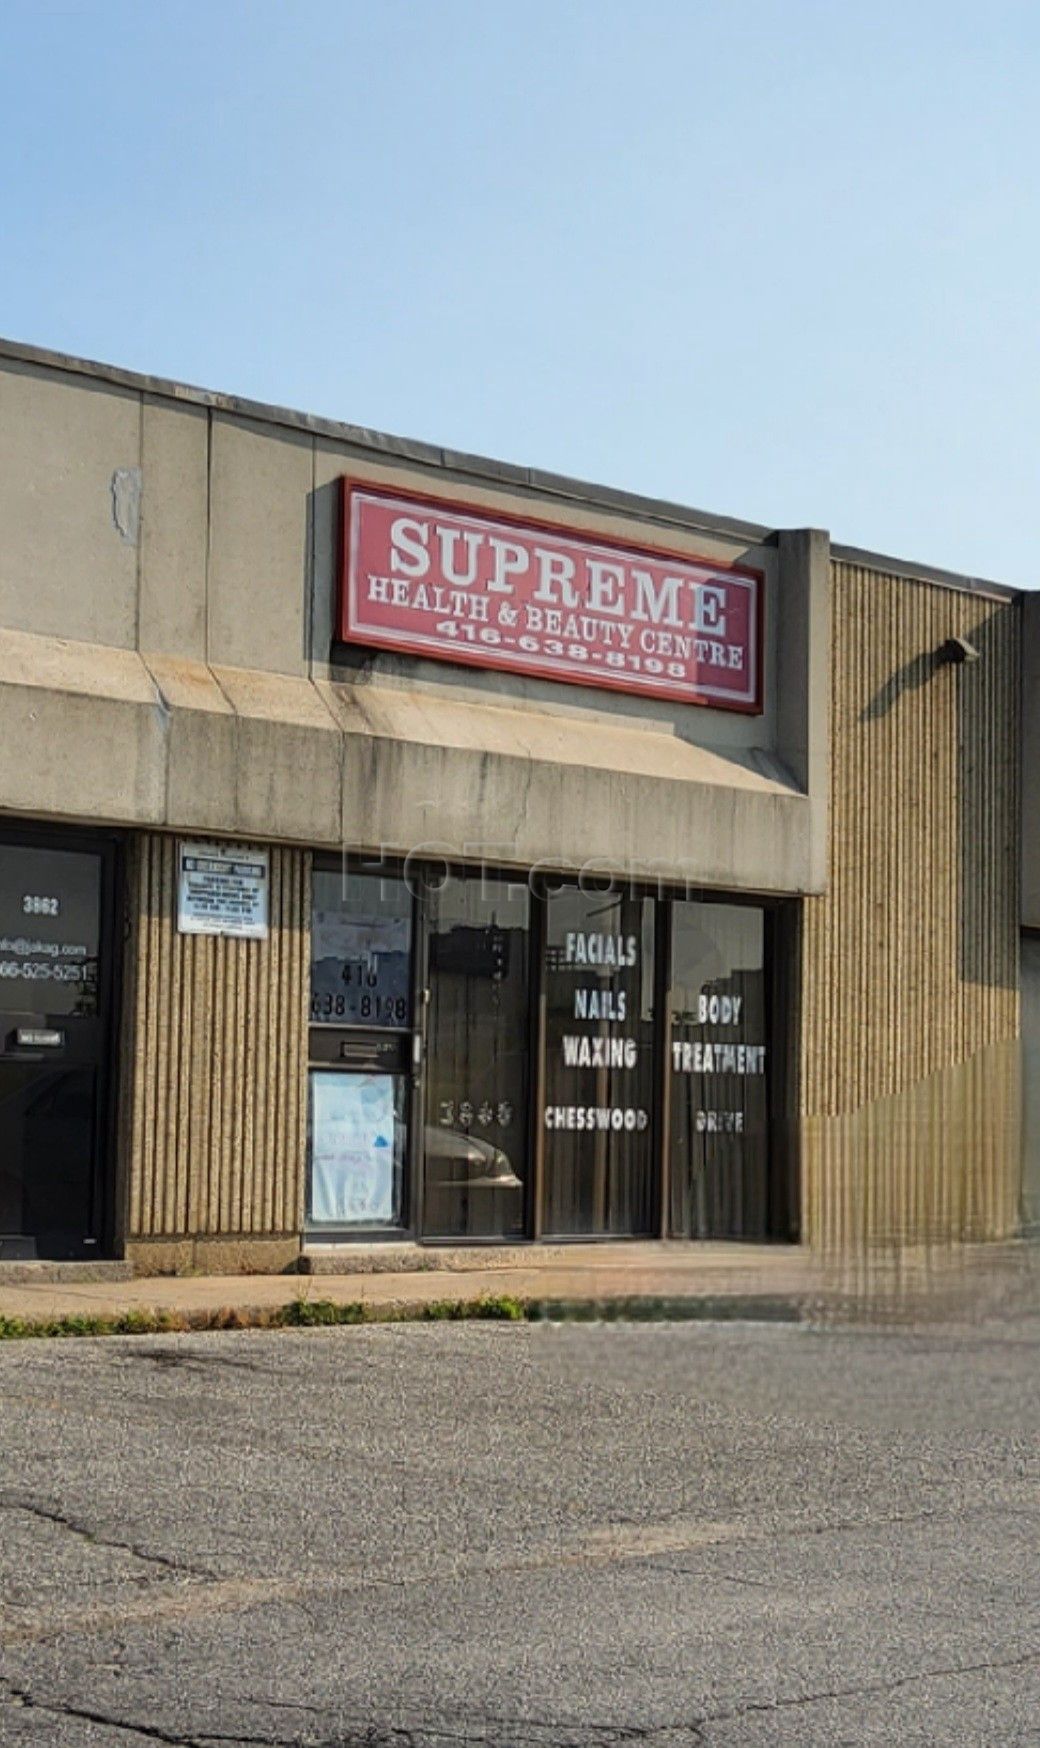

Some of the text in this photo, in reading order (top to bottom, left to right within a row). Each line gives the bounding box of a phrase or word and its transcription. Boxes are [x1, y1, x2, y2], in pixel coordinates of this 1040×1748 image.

[391, 517, 727, 637] SUPREME
[367, 575, 744, 671] HEALTH & BEAUTY CENTRE
[435, 620, 687, 678] 416-638-8198
[566, 933, 637, 966] FACIALS
[574, 989, 627, 1022] NAILS
[698, 994, 743, 1025] BODY
[562, 1035, 638, 1069] WAXING
[672, 1041, 767, 1074] TREATMENT
[545, 1106, 649, 1131] CHESSWOOD
